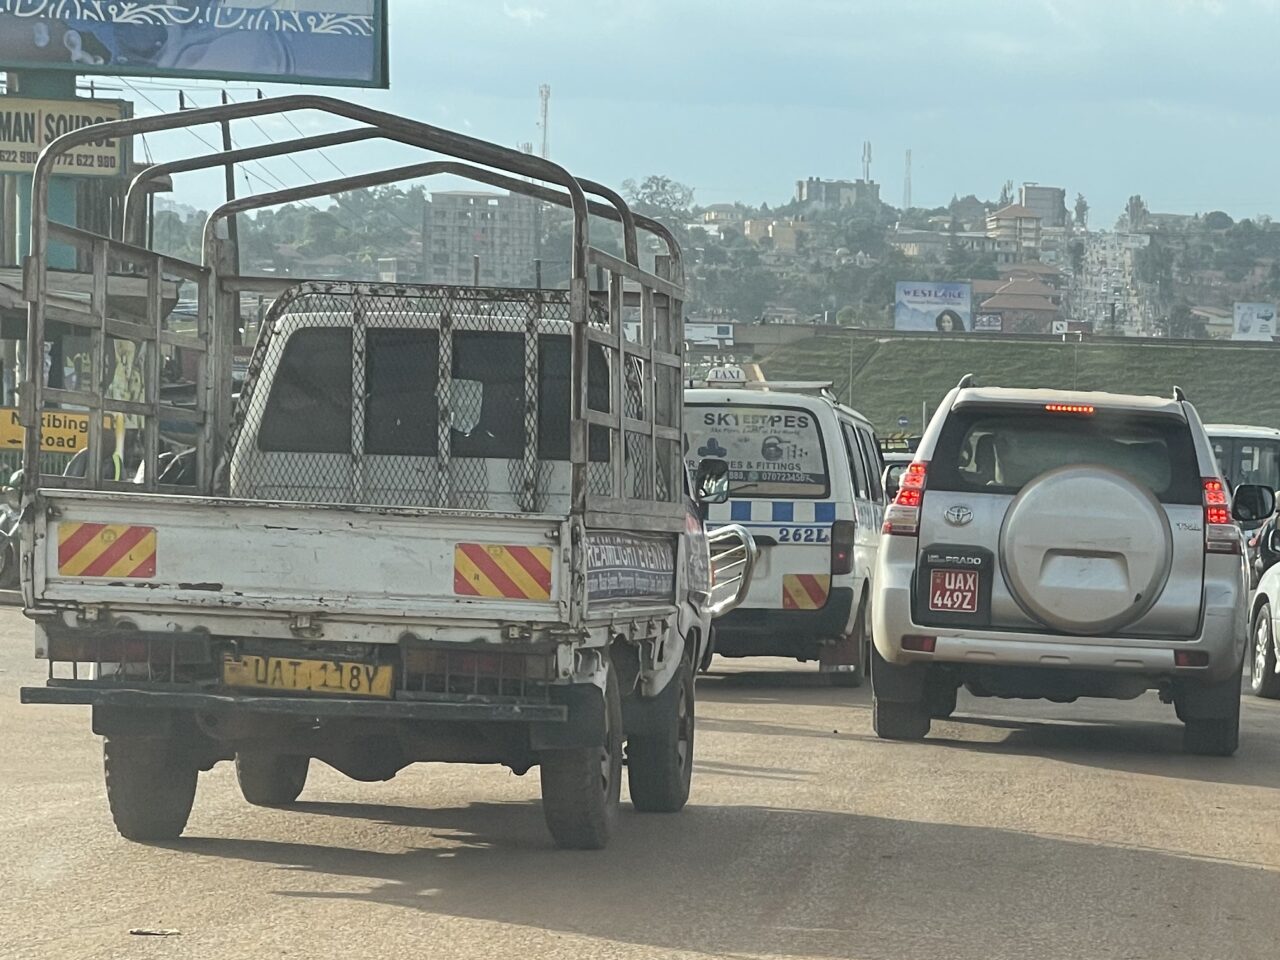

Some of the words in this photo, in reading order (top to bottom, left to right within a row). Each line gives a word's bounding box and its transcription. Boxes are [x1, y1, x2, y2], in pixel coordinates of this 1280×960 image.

[76, 154, 95, 168] 622
[97, 155, 117, 169] 980
[903, 289, 963, 299] WESTLAKE
[714, 370, 741, 379] TAXI
[756, 463, 802, 472] FITTINGS
[779, 528, 829, 543] 262L
[945, 556, 982, 565] PRADO
[945, 573, 975, 591] UAX
[933, 590, 972, 609] 449Z
[255, 658, 302, 688] UAT
[318, 663, 379, 692] 118Y
